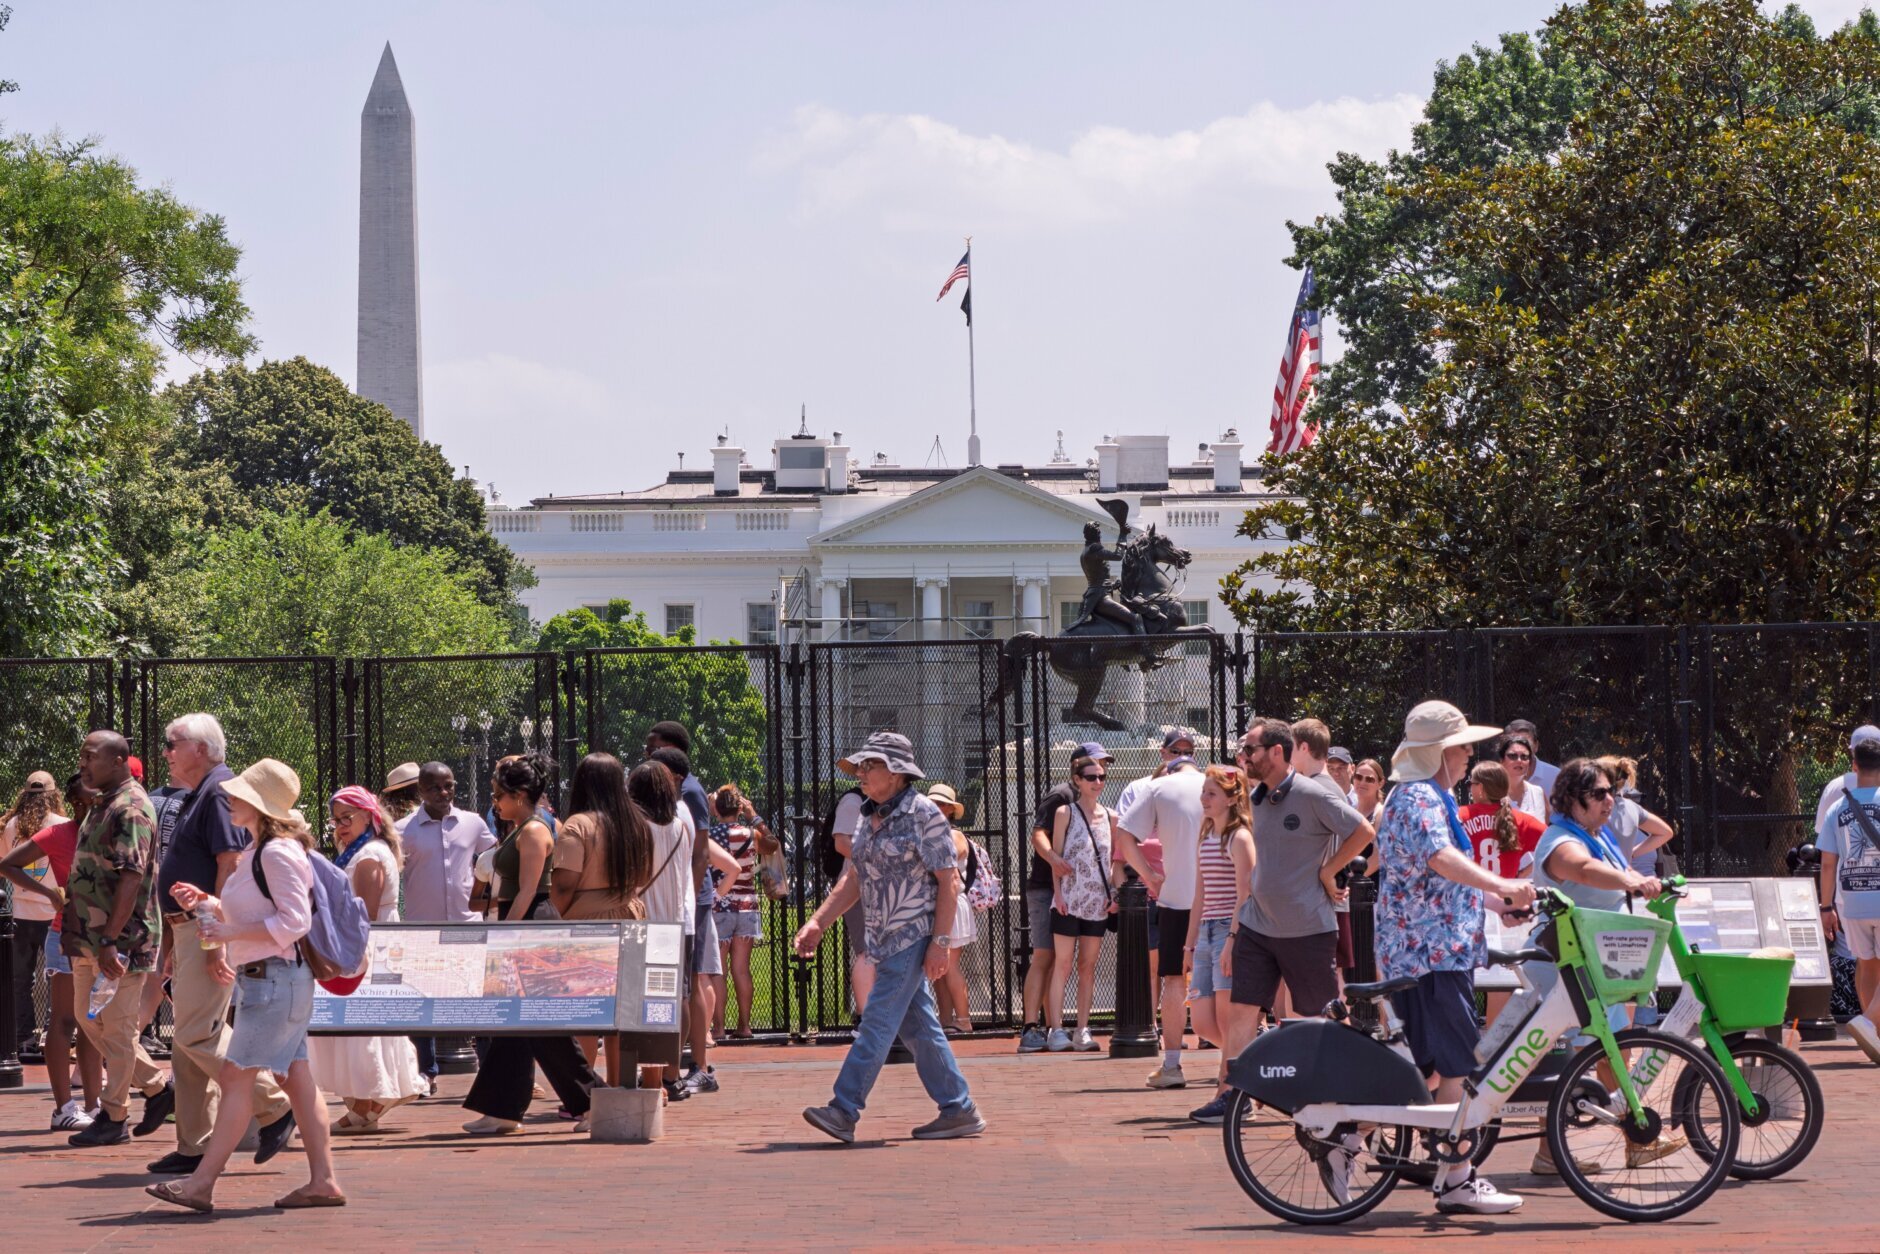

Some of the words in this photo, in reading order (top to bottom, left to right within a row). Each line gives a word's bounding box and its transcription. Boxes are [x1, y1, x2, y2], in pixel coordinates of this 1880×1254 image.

[162, 814, 177, 844] NATION
[1479, 838, 1501, 877] 8
[1851, 867, 1872, 875] AMERICAN
[1867, 879, 1880, 887] 2026
[1486, 1028, 1549, 1093] Lime
[1632, 1048, 1665, 1086] Lim
[1260, 1065, 1297, 1078] Lime
[1528, 1105, 1549, 1113] App
